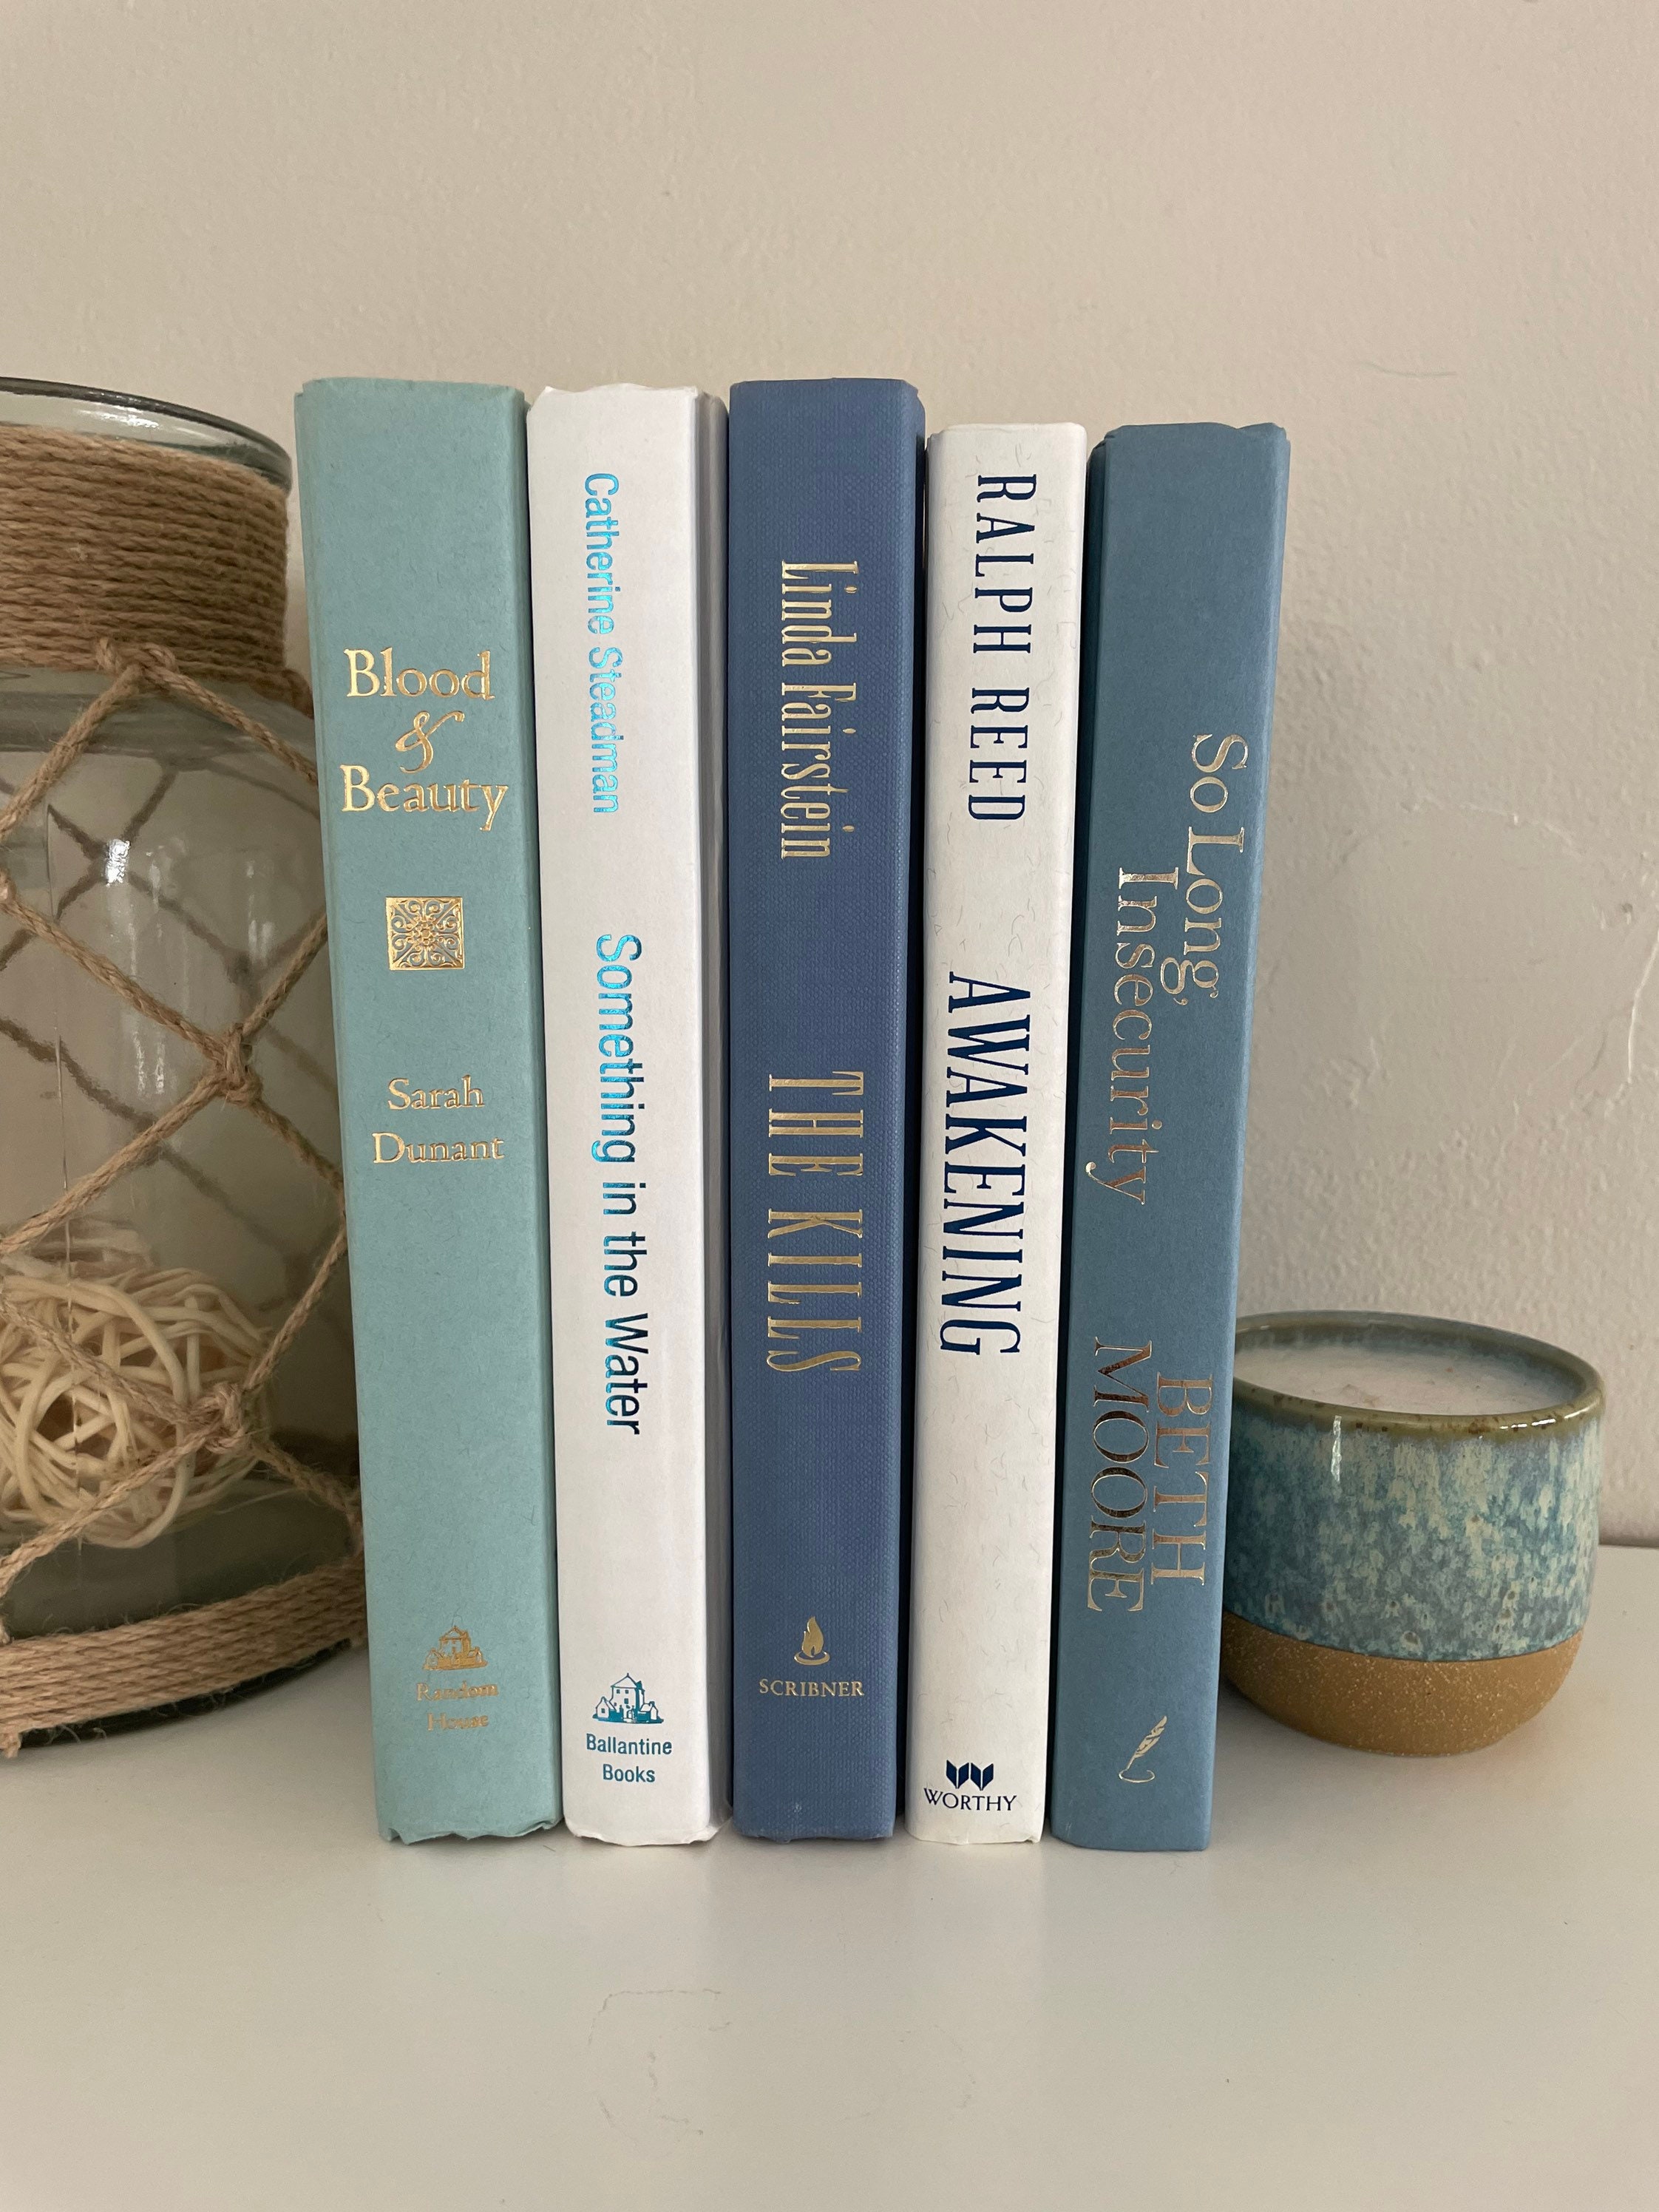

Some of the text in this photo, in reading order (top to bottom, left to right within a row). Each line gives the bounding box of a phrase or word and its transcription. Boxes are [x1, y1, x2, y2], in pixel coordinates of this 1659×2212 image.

[344, 648, 495, 699] Blood
[585, 473, 624, 814] Catherine Steadman
[968, 474, 1037, 821] RALPH REED
[395, 709, 465, 774] &
[780, 560, 859, 860] Linda Fairstein
[340, 764, 509, 832] Beauty
[1160, 733, 1249, 1006] So Long,
[1085, 866, 1179, 1207] Insecurity
[387, 1075, 485, 1111] Sarah
[373, 1131, 505, 1165] Dunant
[940, 971, 1031, 1356] AWAKENING
[591, 932, 648, 1436] Something in the Water
[766, 1071, 864, 1372] THE KILLS
[1087, 1335, 1153, 1612] MOORE
[1150, 1371, 1214, 1587] BETH
[416, 1680, 498, 1702] Random
[759, 1678, 865, 1697] SCRIBNER
[427, 1712, 489, 1732] House
[586, 1733, 673, 1755] Ballantine
[603, 1764, 656, 1783] Books
[923, 1787, 1017, 1811] WORTHY
